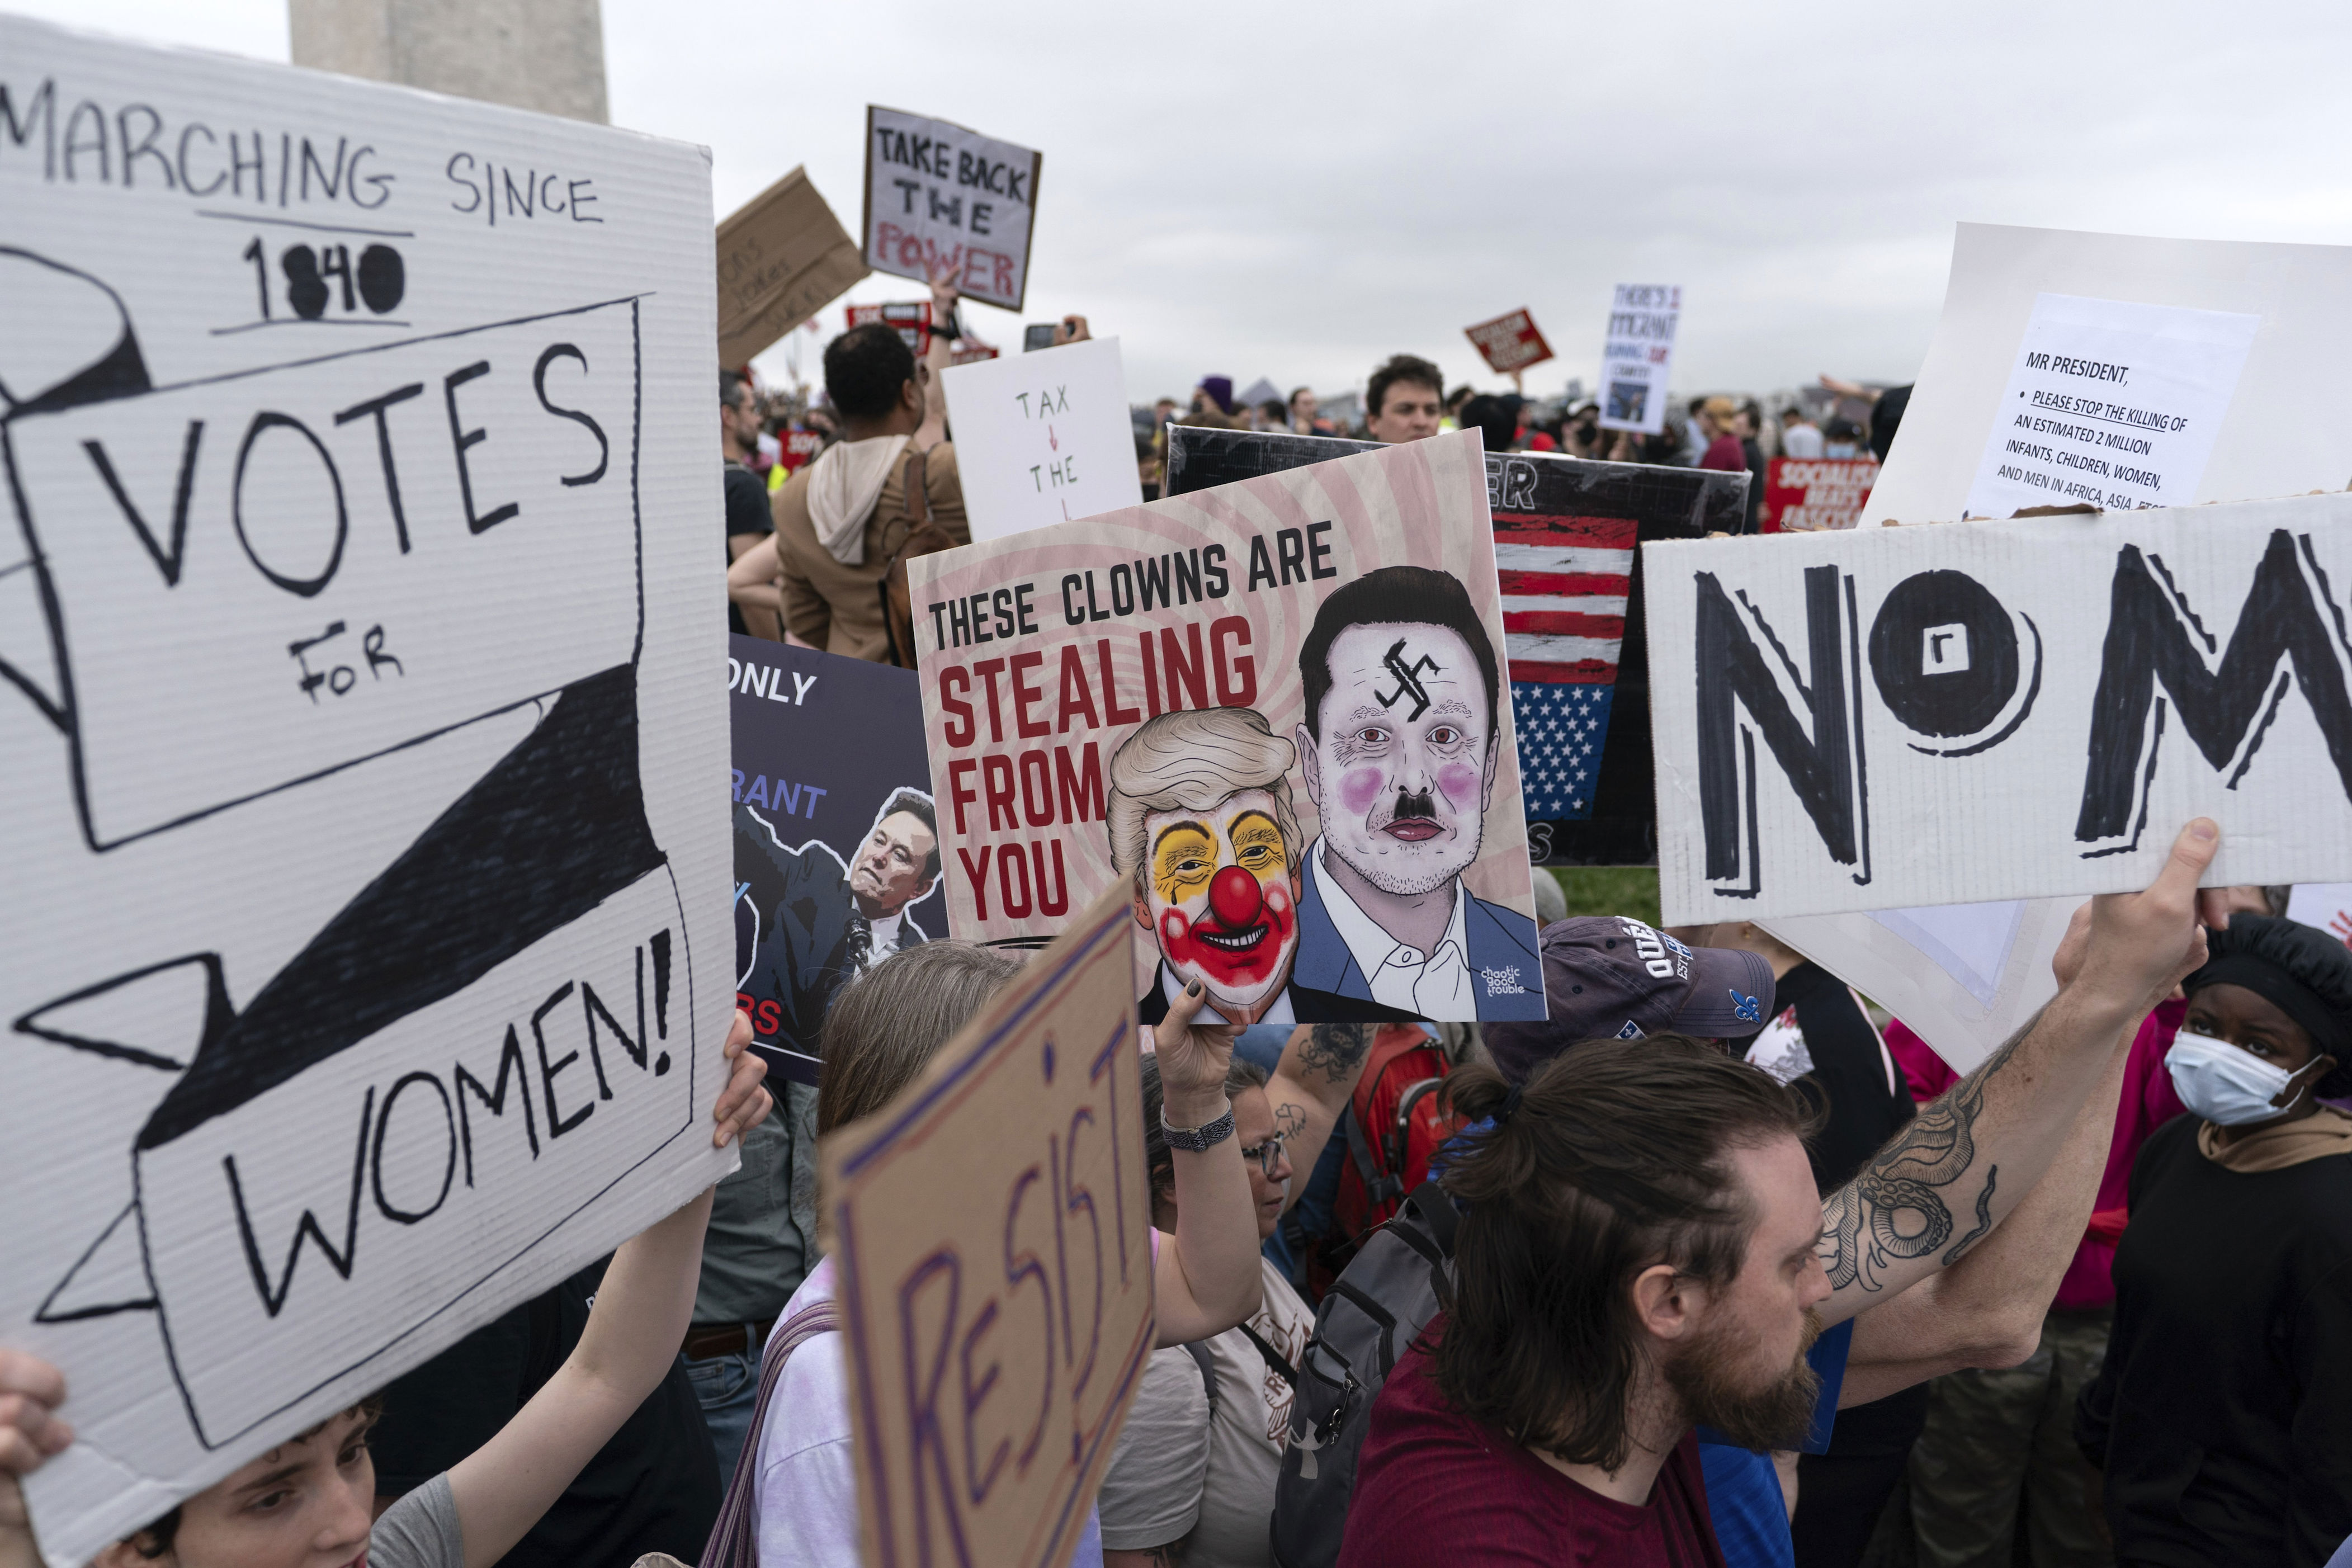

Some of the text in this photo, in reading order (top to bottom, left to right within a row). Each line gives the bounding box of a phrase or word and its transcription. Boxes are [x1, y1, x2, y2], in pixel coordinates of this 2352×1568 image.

[0, 77, 604, 226] MARCHING SINCE
[876, 126, 1028, 202] TAKE BACK
[893, 177, 994, 236] THE
[243, 233, 405, 320] 1840
[877, 221, 1014, 297] POWER
[2026, 352, 2129, 388] MR PRESIDENT,
[1016, 384, 1070, 419] TAX
[2032, 390, 2188, 433] PLEASE STOP THE KILLING OF
[2014, 414, 2152, 456] AN ESTIMATED 2 MILLION
[79, 342, 609, 599] VOTES
[1030, 455, 1078, 493] THE
[1997, 464, 2023, 481] AND
[2023, 471, 2050, 489] MEN
[2050, 478, 2064, 493] IN
[2063, 481, 2104, 506] AFRICA,
[2106, 493, 2133, 511] ASIA
[2006, 439, 2161, 492] INFANTS, CHILDREN, WOMEN,
[928, 520, 1338, 650] THESE CLOWNS ARE
[938, 614, 1258, 749] STEALING
[948, 741, 1107, 835] FROM
[957, 838, 1069, 922] YOU
[1481, 965, 1520, 978] chaotic
[1486, 974, 1515, 987] good
[1487, 983, 1525, 997] trouble
[1676, 955, 1690, 980] EST.
[223, 926, 673, 1319] WOMEN!
